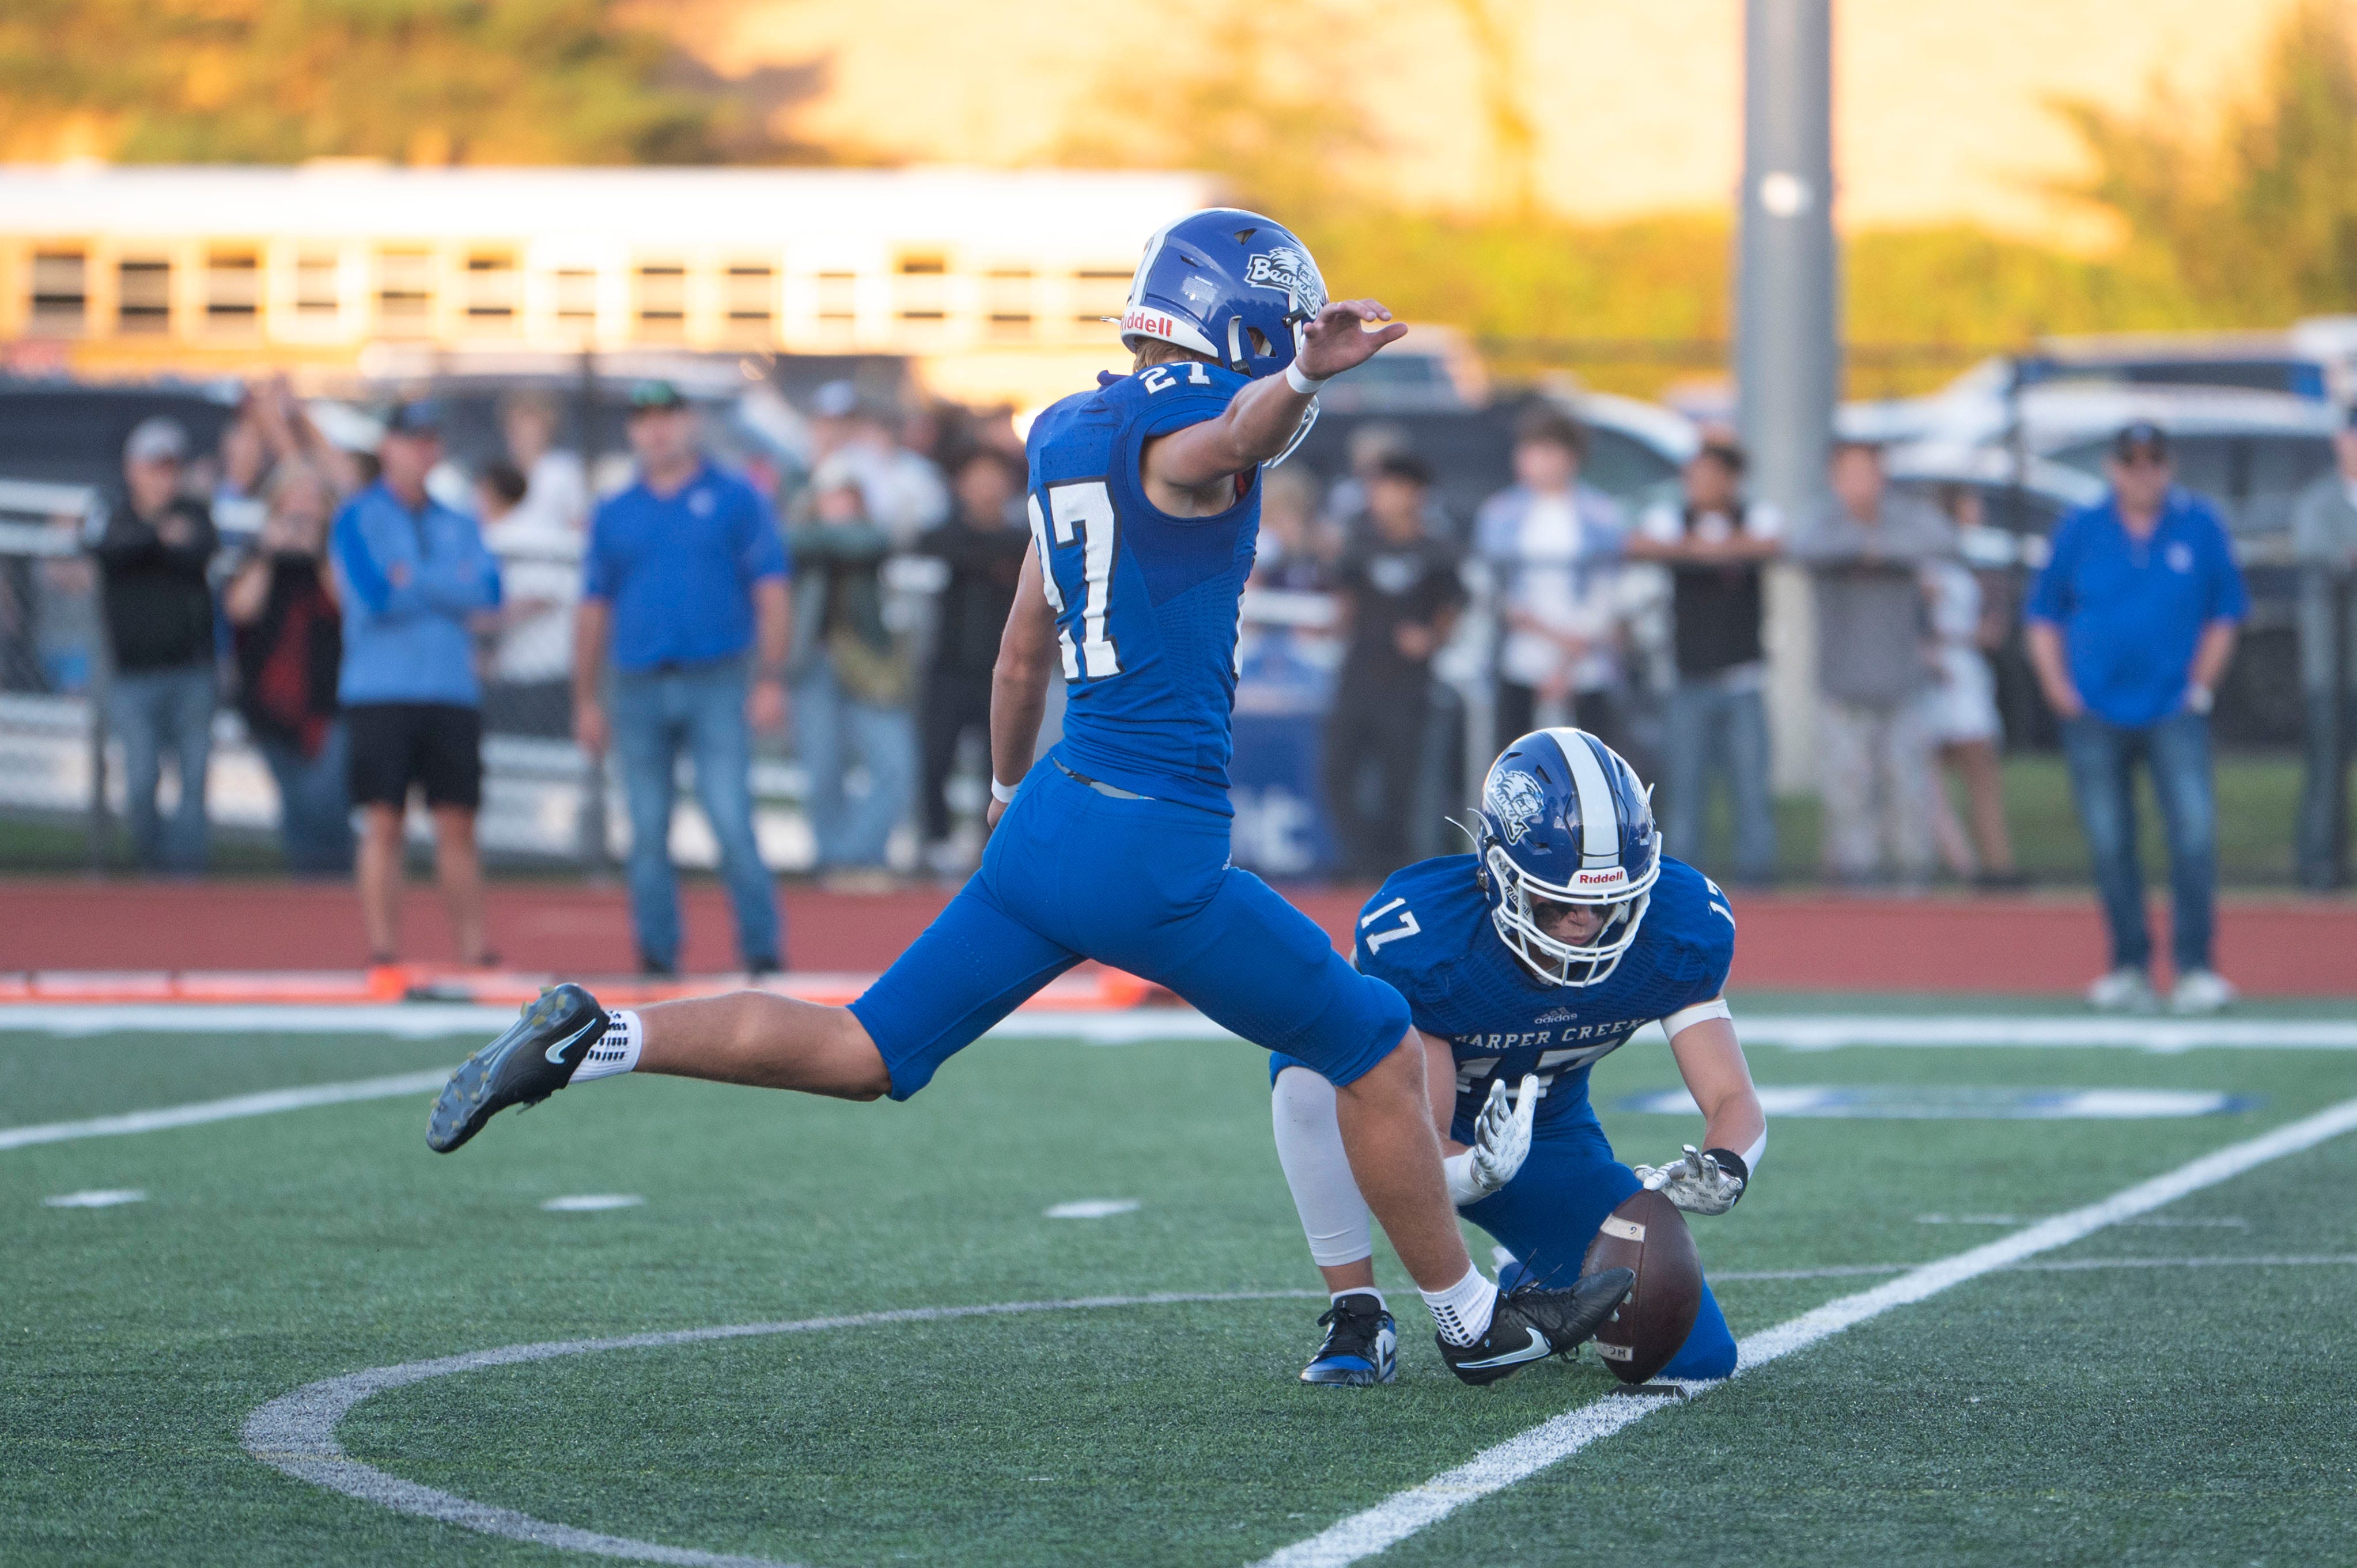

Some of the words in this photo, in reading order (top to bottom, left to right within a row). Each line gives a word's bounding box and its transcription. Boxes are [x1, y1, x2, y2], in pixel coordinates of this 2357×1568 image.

[1138, 361, 1210, 395] 27
[1580, 870, 1623, 884] Riddell
[1360, 897, 1422, 956] 17
[1534, 1013, 1578, 1025] adidas
